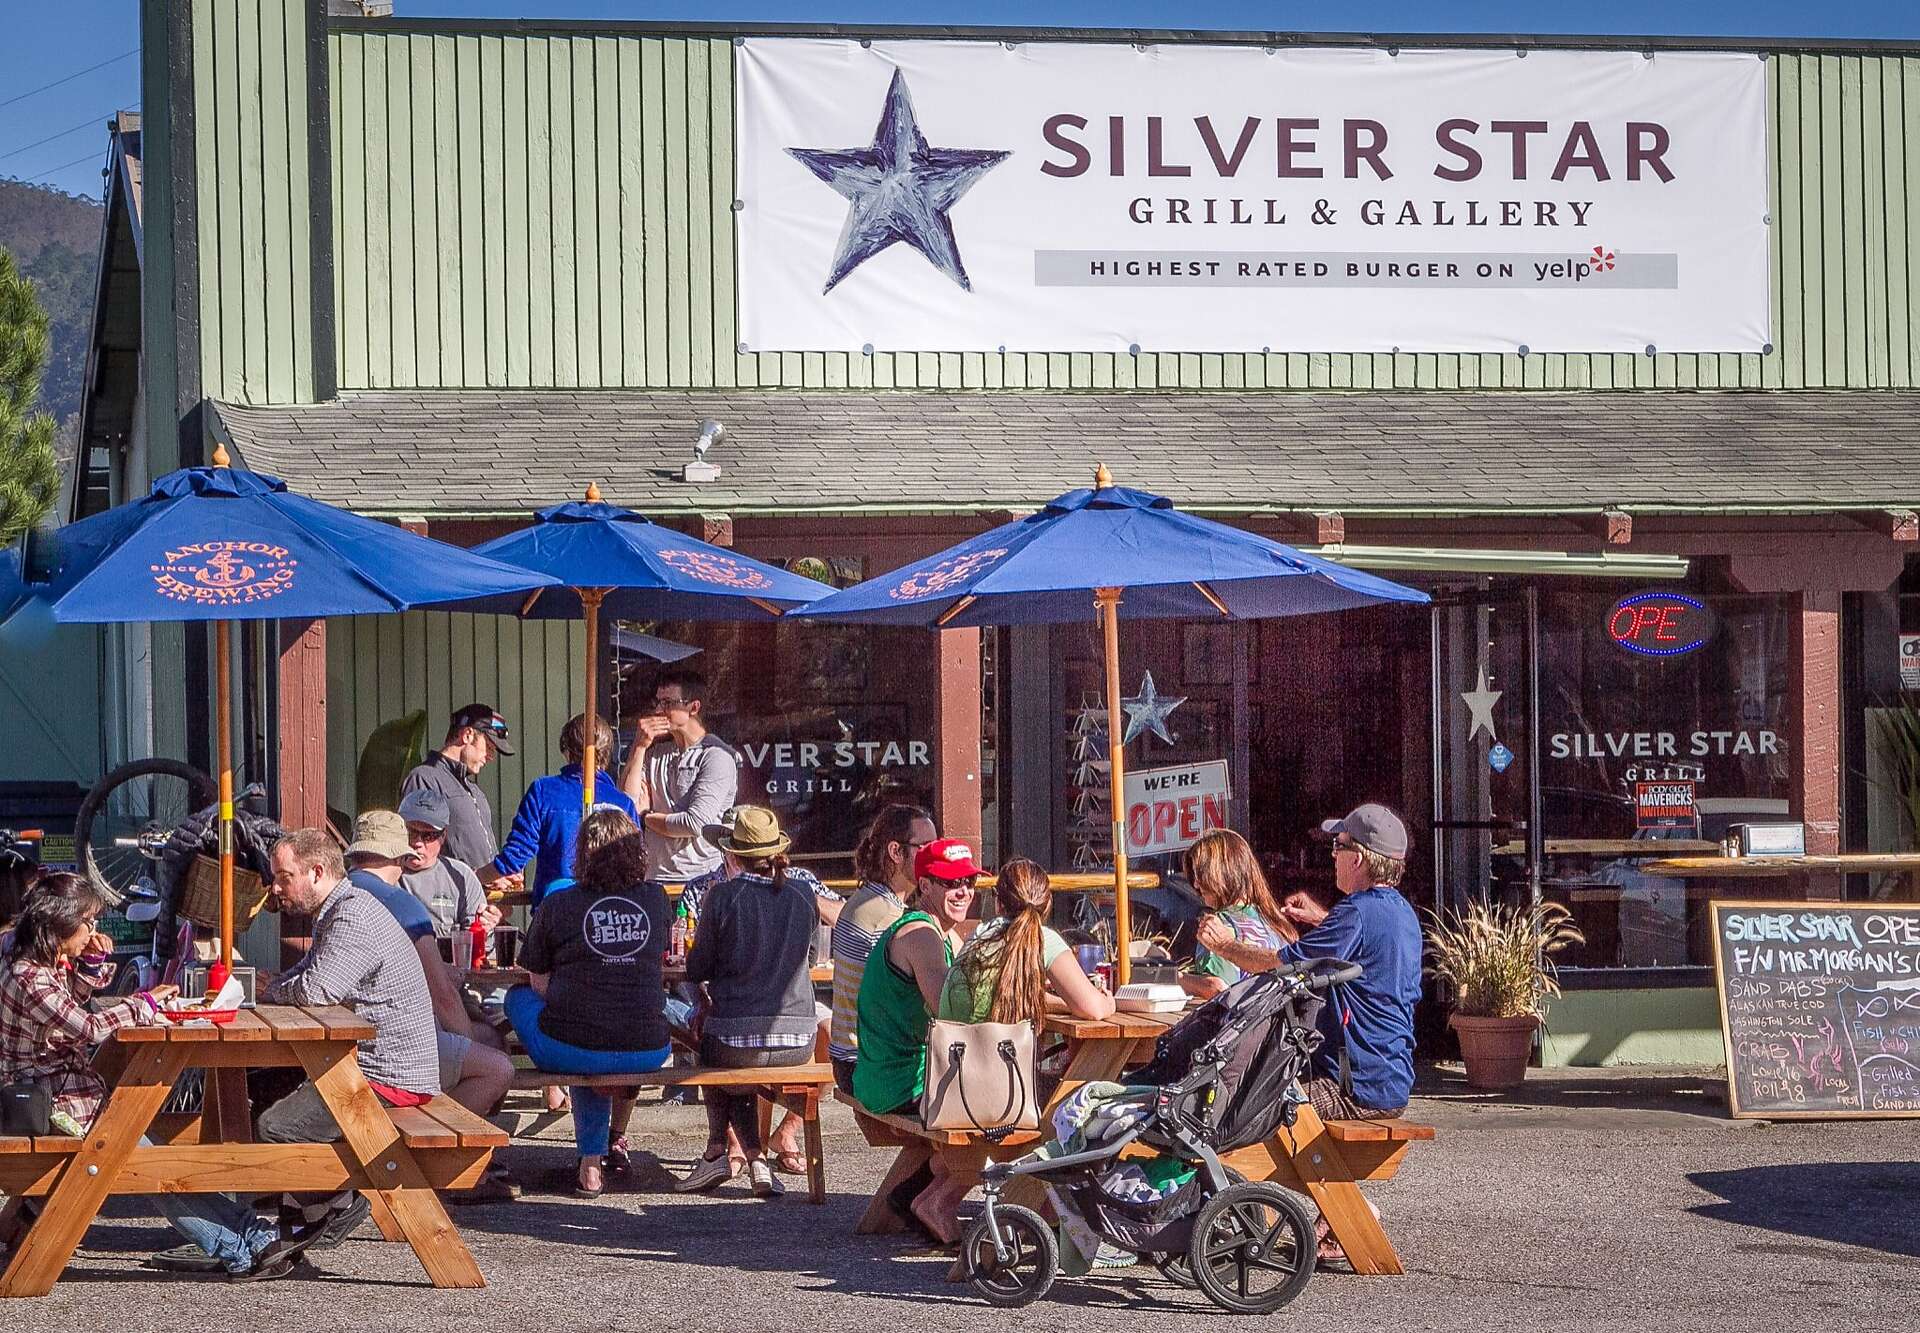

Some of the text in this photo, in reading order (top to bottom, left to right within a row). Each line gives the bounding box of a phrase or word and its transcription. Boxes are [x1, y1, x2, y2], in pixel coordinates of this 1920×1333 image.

[1039, 113, 1676, 184] SILVER STAR
[1128, 197, 1594, 227] GRILL & GALLERY
[1090, 257, 1590, 282] HIGHEST RATED BURGER ON yelp
[165, 541, 289, 563] ANCHOR
[154, 569, 294, 598] BREWING
[157, 582, 293, 605] SAN FRANCISCO
[835, 741, 930, 767] STAR
[1551, 731, 1779, 759] SILVER STAR
[1143, 771, 1201, 791] WE'RE
[1625, 767, 1707, 782] GRILL
[765, 779, 852, 794] GRILL
[1640, 793, 1693, 807] MAVERICKS
[1128, 791, 1226, 848] OPEN
[1640, 806, 1693, 817] INVITATIONAL
[591, 909, 643, 929] Pliny
[600, 924, 648, 944] Elder
[1796, 912, 1863, 949] STAR
[1734, 945, 1774, 975] F/V
[1730, 978, 1771, 998] SAND
[1779, 980, 1826, 1000] DABS
[1730, 998, 1826, 1013] ALASKAN TRUE COD
[1786, 1015, 1814, 1026] SOLE
[1898, 1025, 1920, 1039] CHI
[1738, 1041, 1790, 1060] CRAB
[1871, 1065, 1914, 1082] Grilled
[1753, 1081, 1779, 1099] Roll
